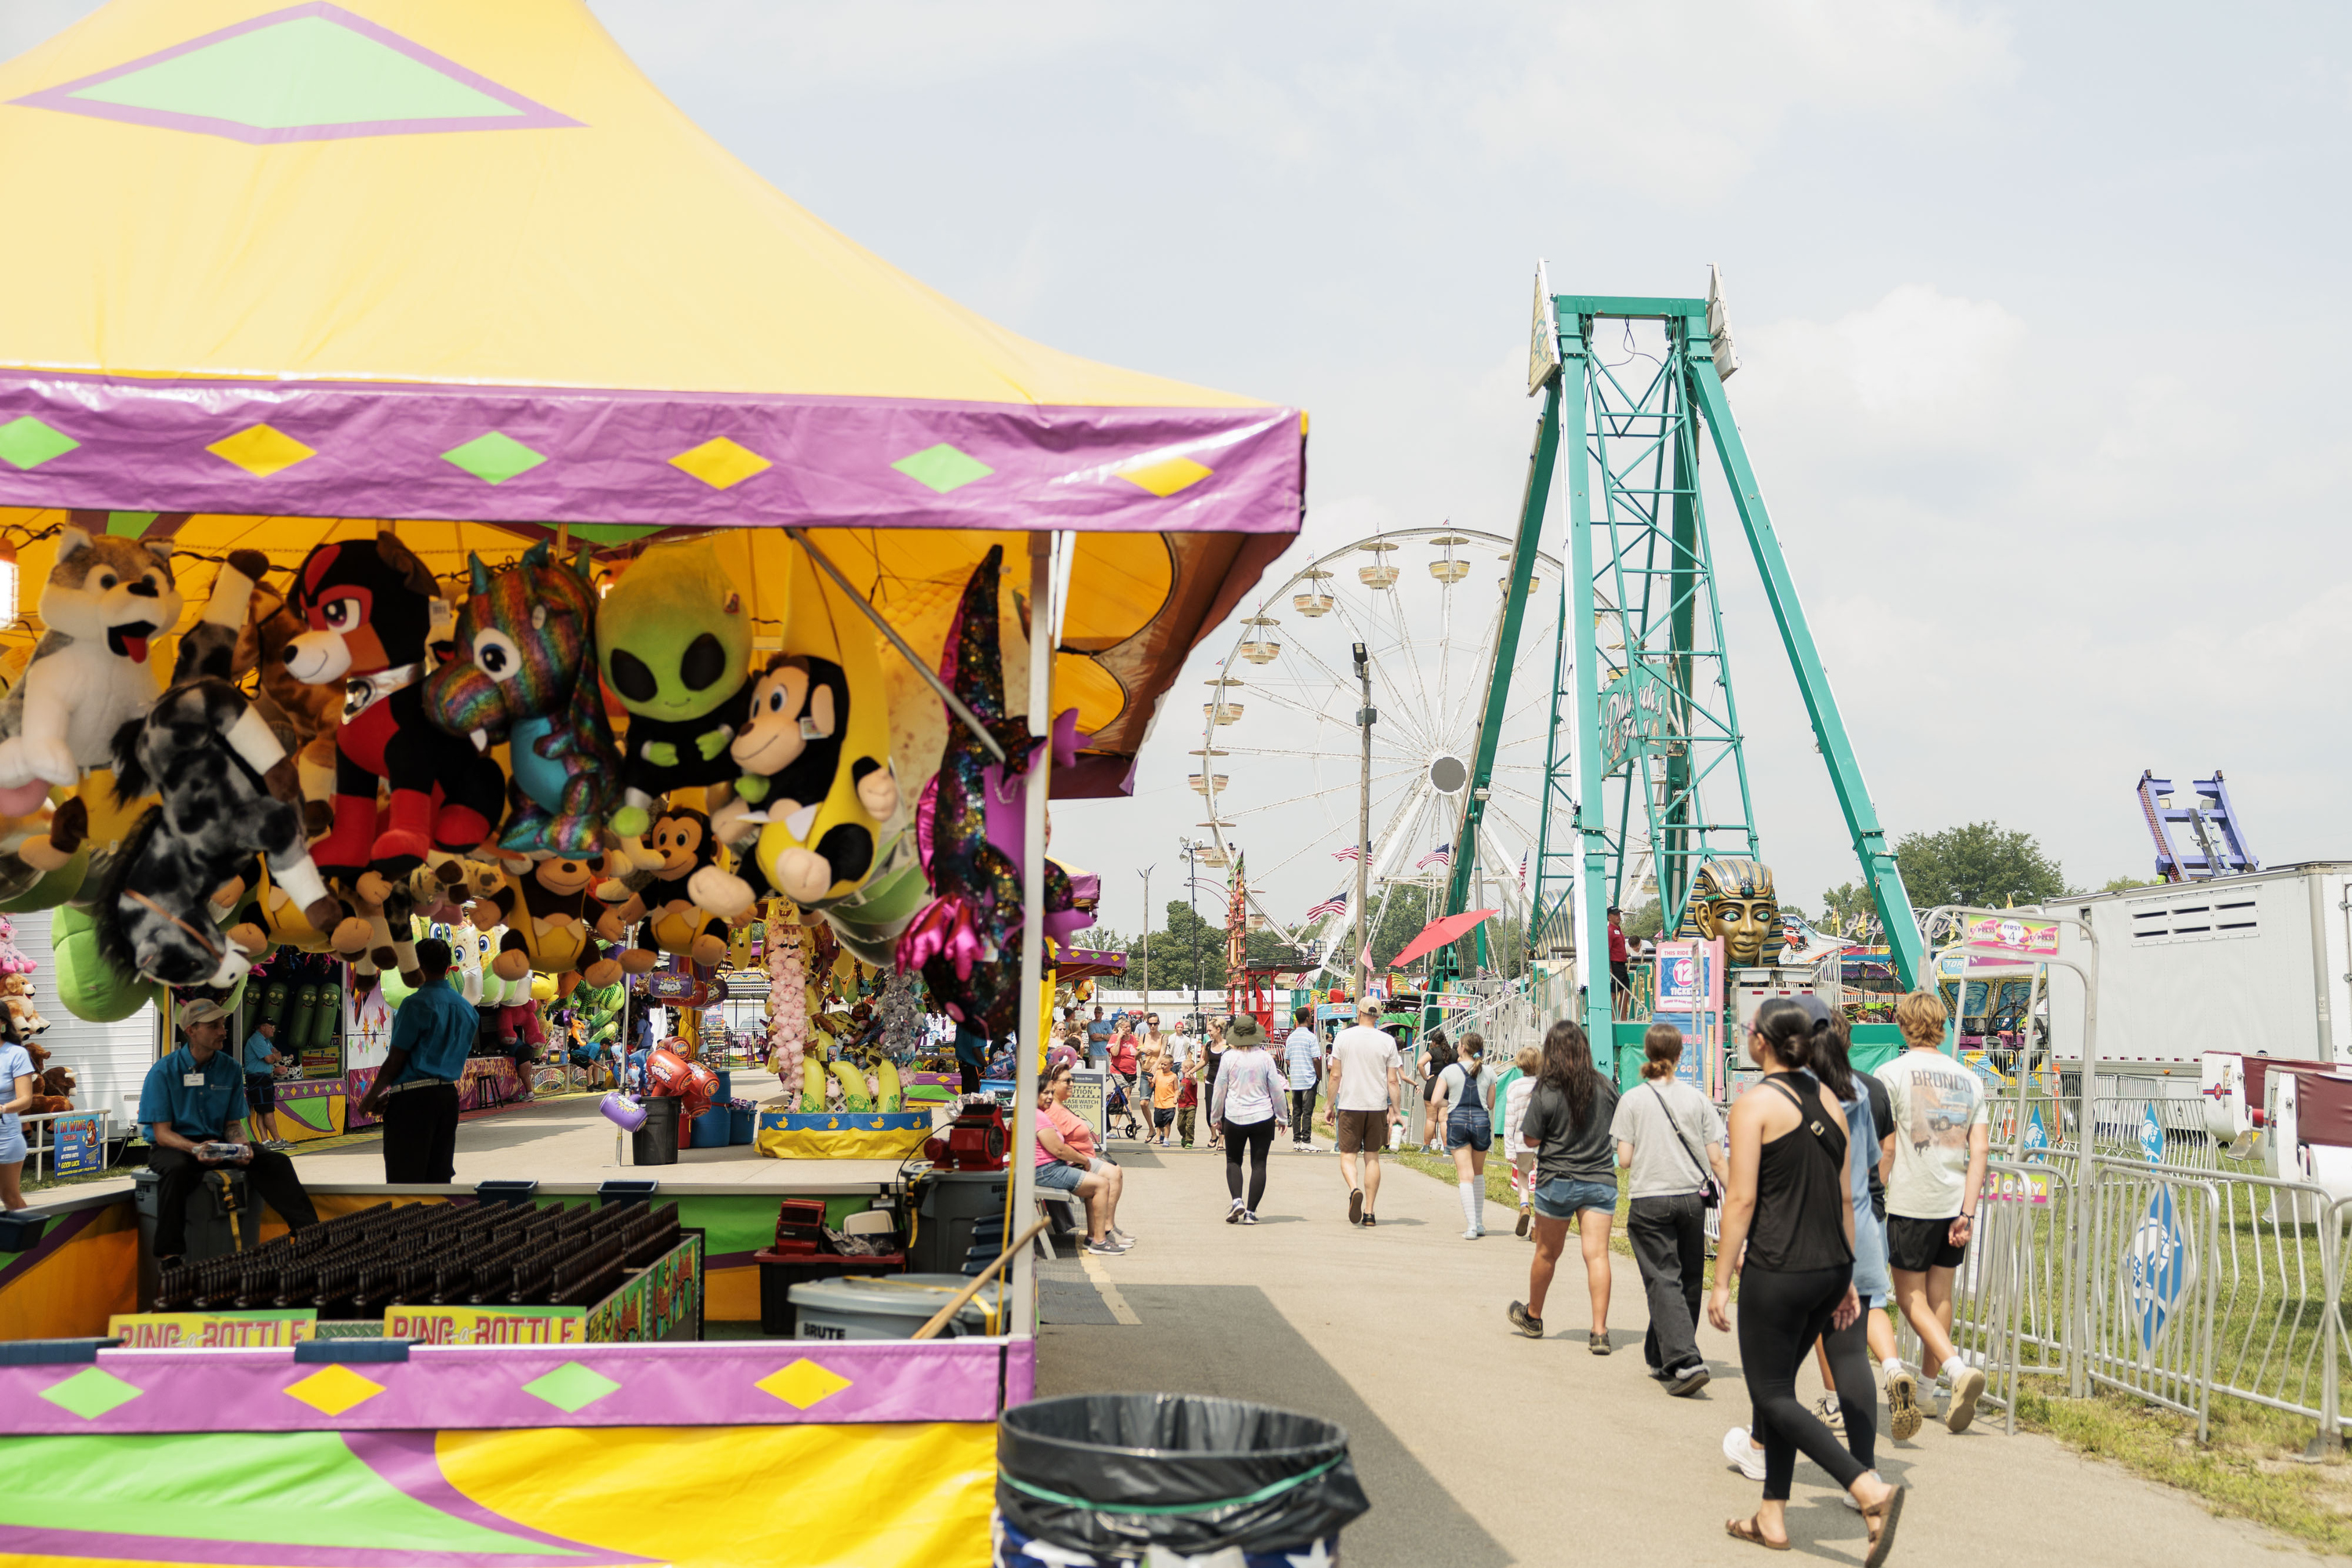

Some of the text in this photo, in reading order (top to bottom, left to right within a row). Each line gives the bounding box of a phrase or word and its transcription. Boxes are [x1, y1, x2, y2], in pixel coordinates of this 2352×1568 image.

[2009, 932, 2016, 942] 4
[1911, 1070, 1972, 1093] BRONCO
[60, 1121, 67, 1133] IN
[69, 1120, 86, 1131] WINS
[804, 1323, 846, 1339] BRUTE
